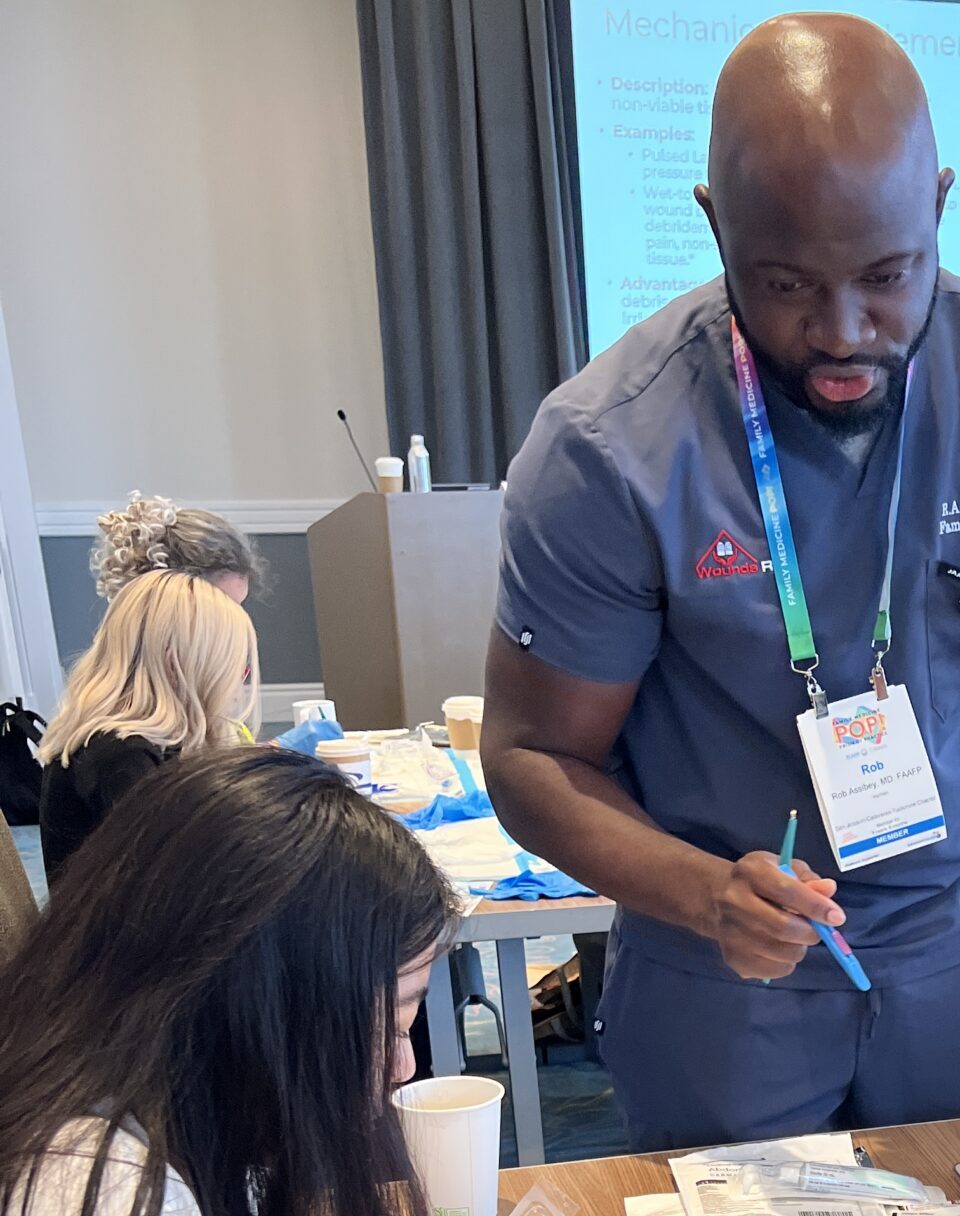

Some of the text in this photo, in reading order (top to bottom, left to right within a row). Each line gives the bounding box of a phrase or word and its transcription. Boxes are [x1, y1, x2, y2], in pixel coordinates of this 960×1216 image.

[605, 8, 753, 43] Mechanic
[611, 76, 709, 96] Description:
[611, 97, 694, 114] non-viable
[613, 124, 695, 143] Examples:
[642, 148, 690, 164] Pulsed
[642, 166, 703, 181] pressure
[643, 204, 694, 218] wound
[644, 219, 709, 234] debridem
[742, 363, 768, 459] FAMILY MEDICINE
[771, 513, 789, 567] MEDICINE
[698, 562, 759, 579] Wounds
[781, 568, 797, 607] FAMILY
[860, 760, 884, 776] Rob
[831, 789, 847, 801] Rob
[875, 828, 910, 845] MEMBER
